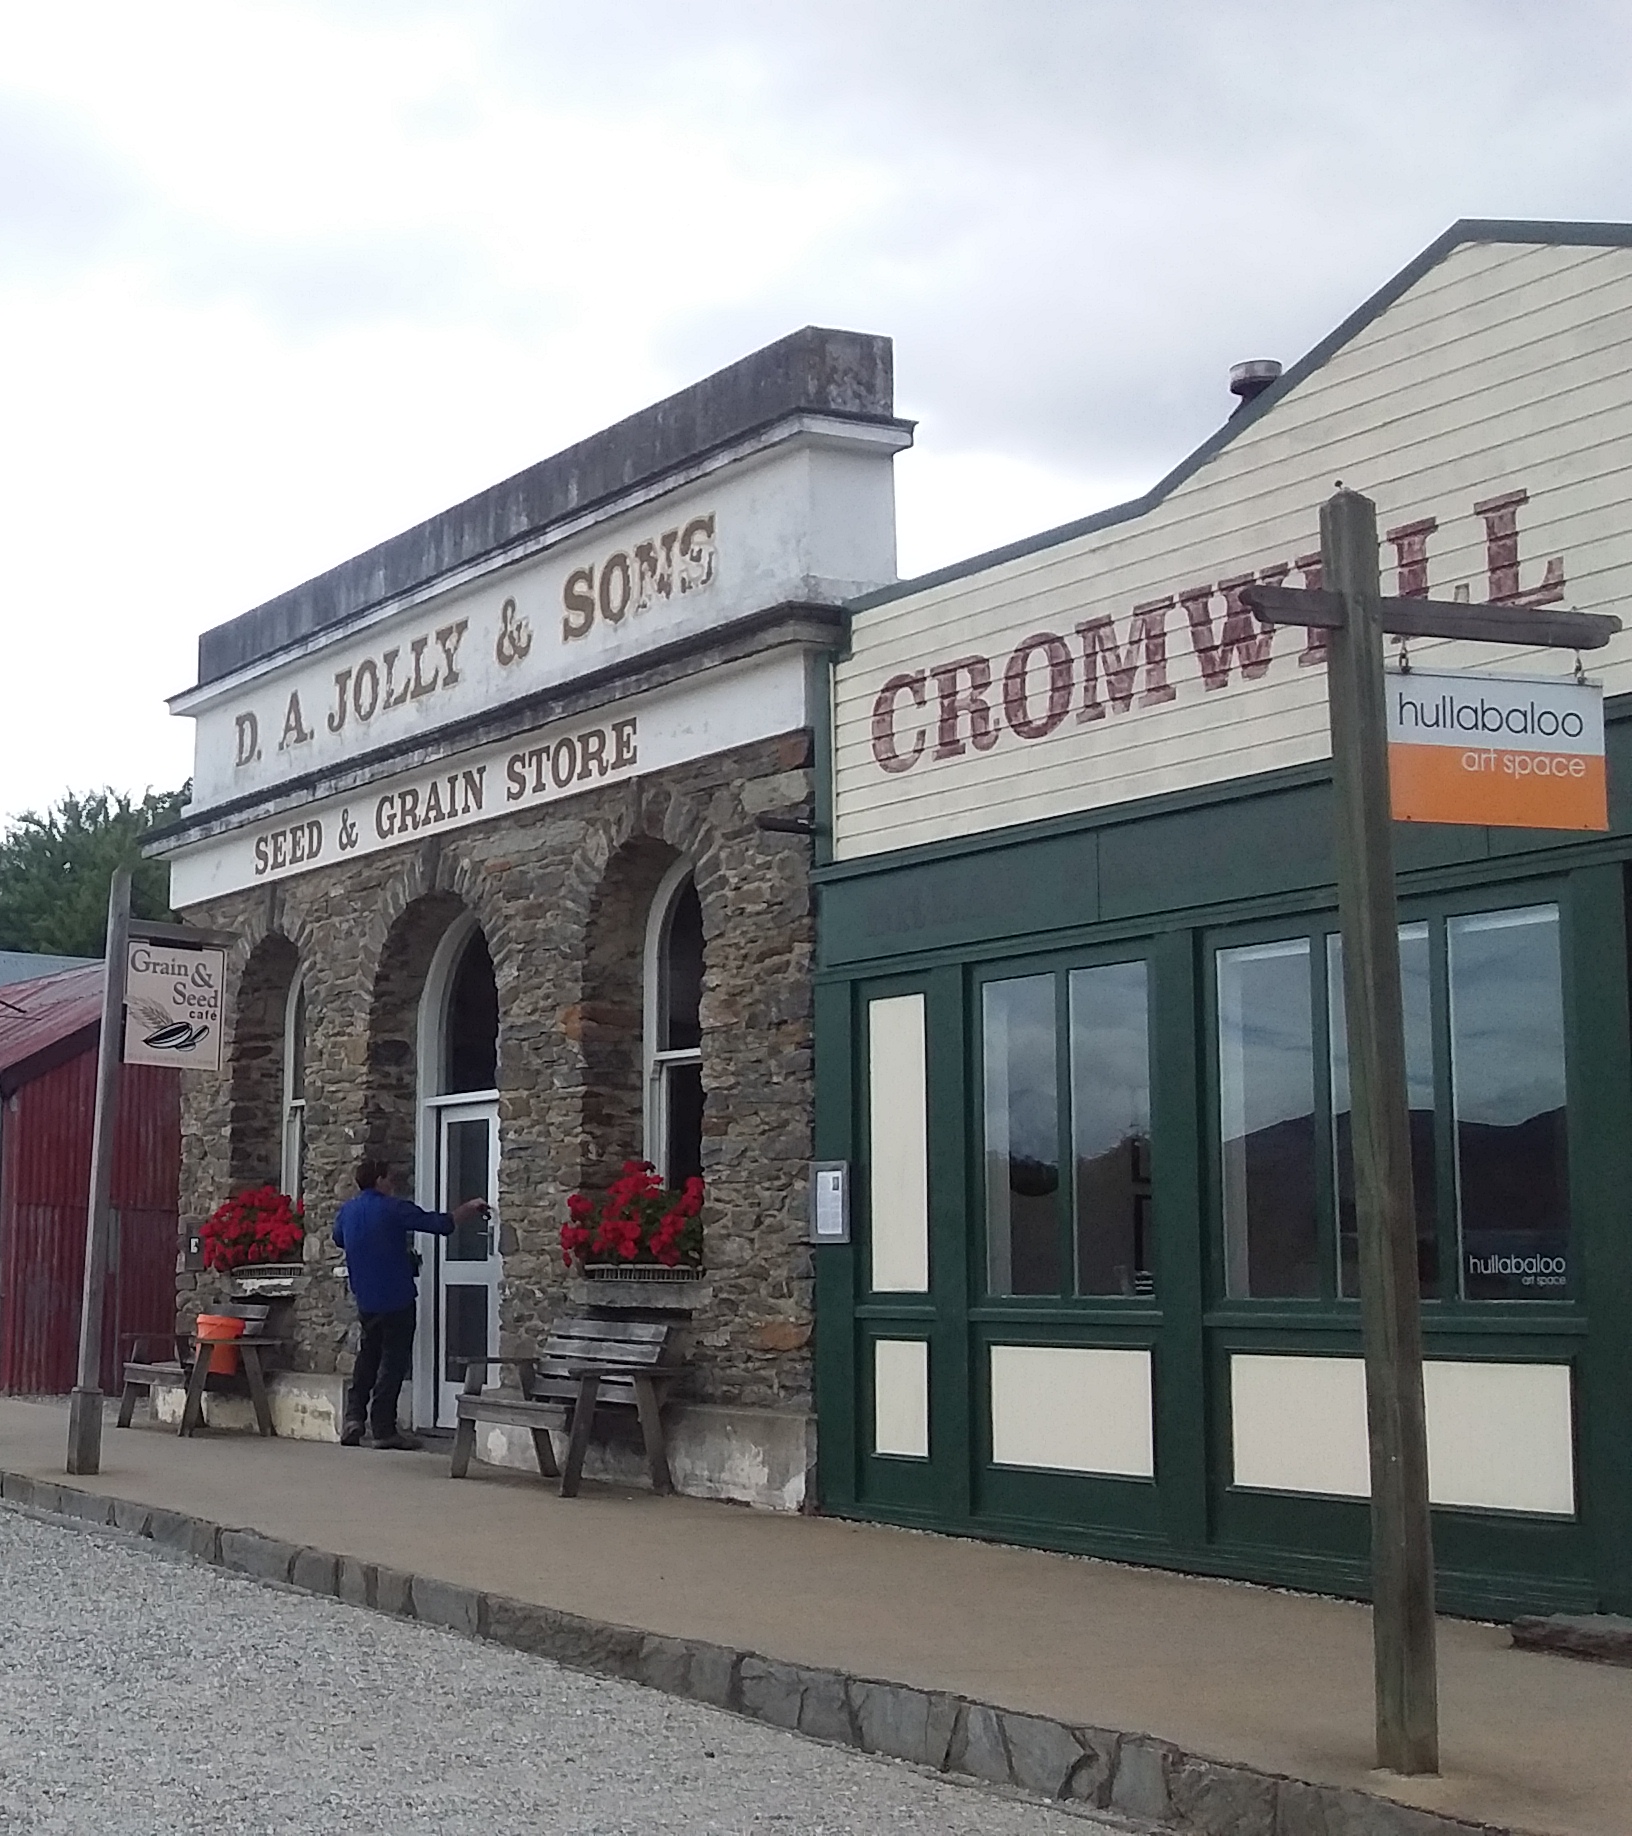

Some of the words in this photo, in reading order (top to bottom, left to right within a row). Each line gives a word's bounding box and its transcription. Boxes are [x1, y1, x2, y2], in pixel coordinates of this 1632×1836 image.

[235, 710, 262, 767] D.
[278, 689, 315, 750] A.
[328, 617, 469, 732] JOLLY
[496, 597, 532, 666] &
[562, 511, 716, 642] SONS
[870, 488, 1566, 774] CROMWLL
[1398, 692, 1584, 738] hullabaloo
[1461, 748, 1498, 772] art
[1503, 755, 1586, 779] space
[254, 819, 323, 875] SEED
[339, 808, 359, 851] &
[375, 766, 487, 839] GRAIN
[506, 717, 638, 801] STORE
[131, 949, 190, 977] Grain
[191, 963, 214, 988] &
[172, 982, 219, 1009] Seed
[1469, 1253, 1567, 1274] hullabaloo
[1521, 1275, 1535, 1286] art
[1536, 1275, 1567, 1287] space
